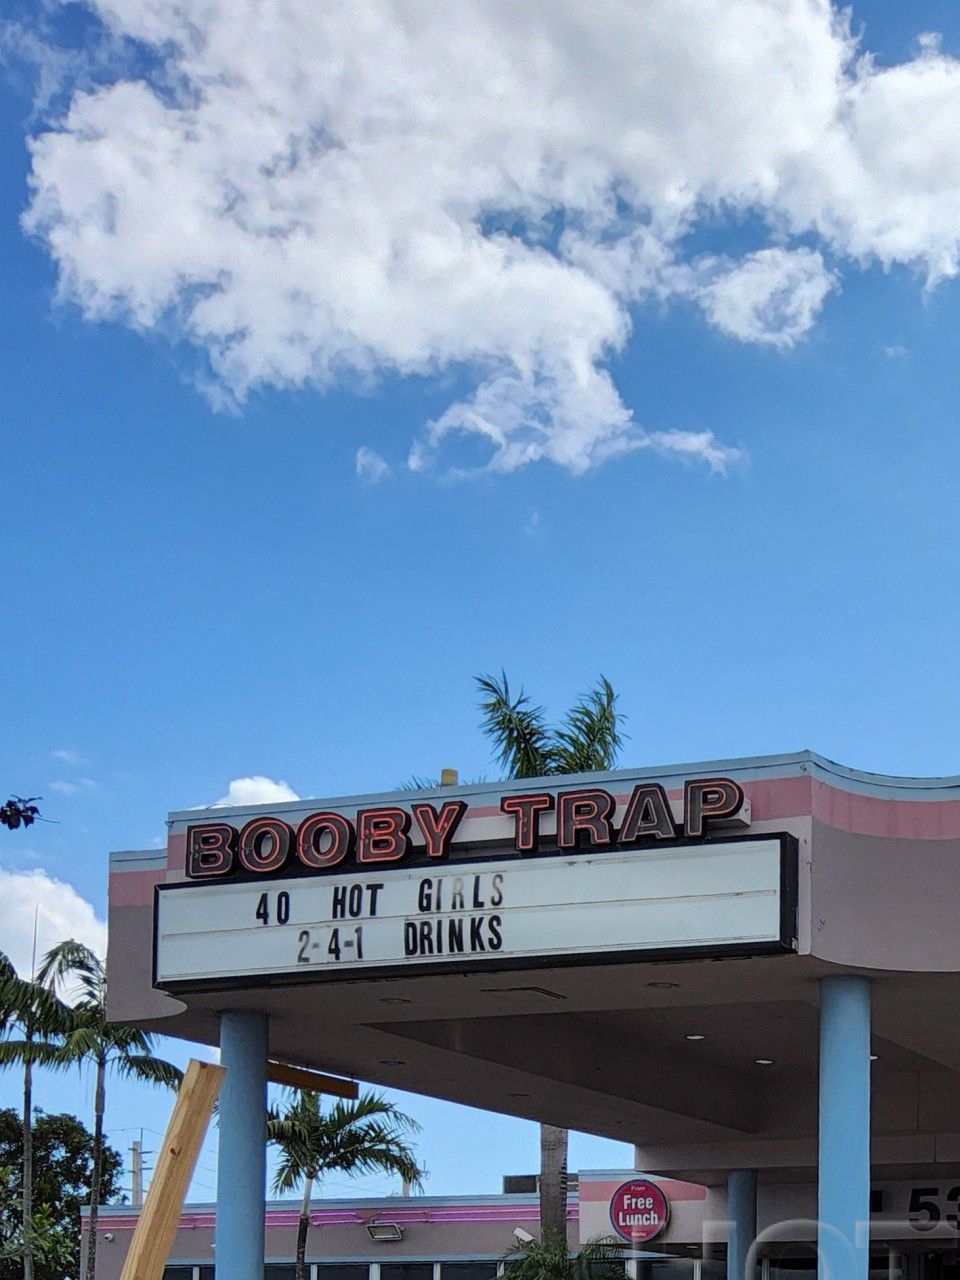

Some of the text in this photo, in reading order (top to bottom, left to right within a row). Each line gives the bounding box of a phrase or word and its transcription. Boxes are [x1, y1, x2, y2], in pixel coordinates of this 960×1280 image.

[186, 777, 745, 878] BOOBY TRAP
[255, 874, 504, 925] 40 HOT GIRLS
[297, 915, 503, 963] 2-4-1 DRINKS
[618, 1210, 659, 1226] Lunch
[623, 1194, 654, 1210] Free
